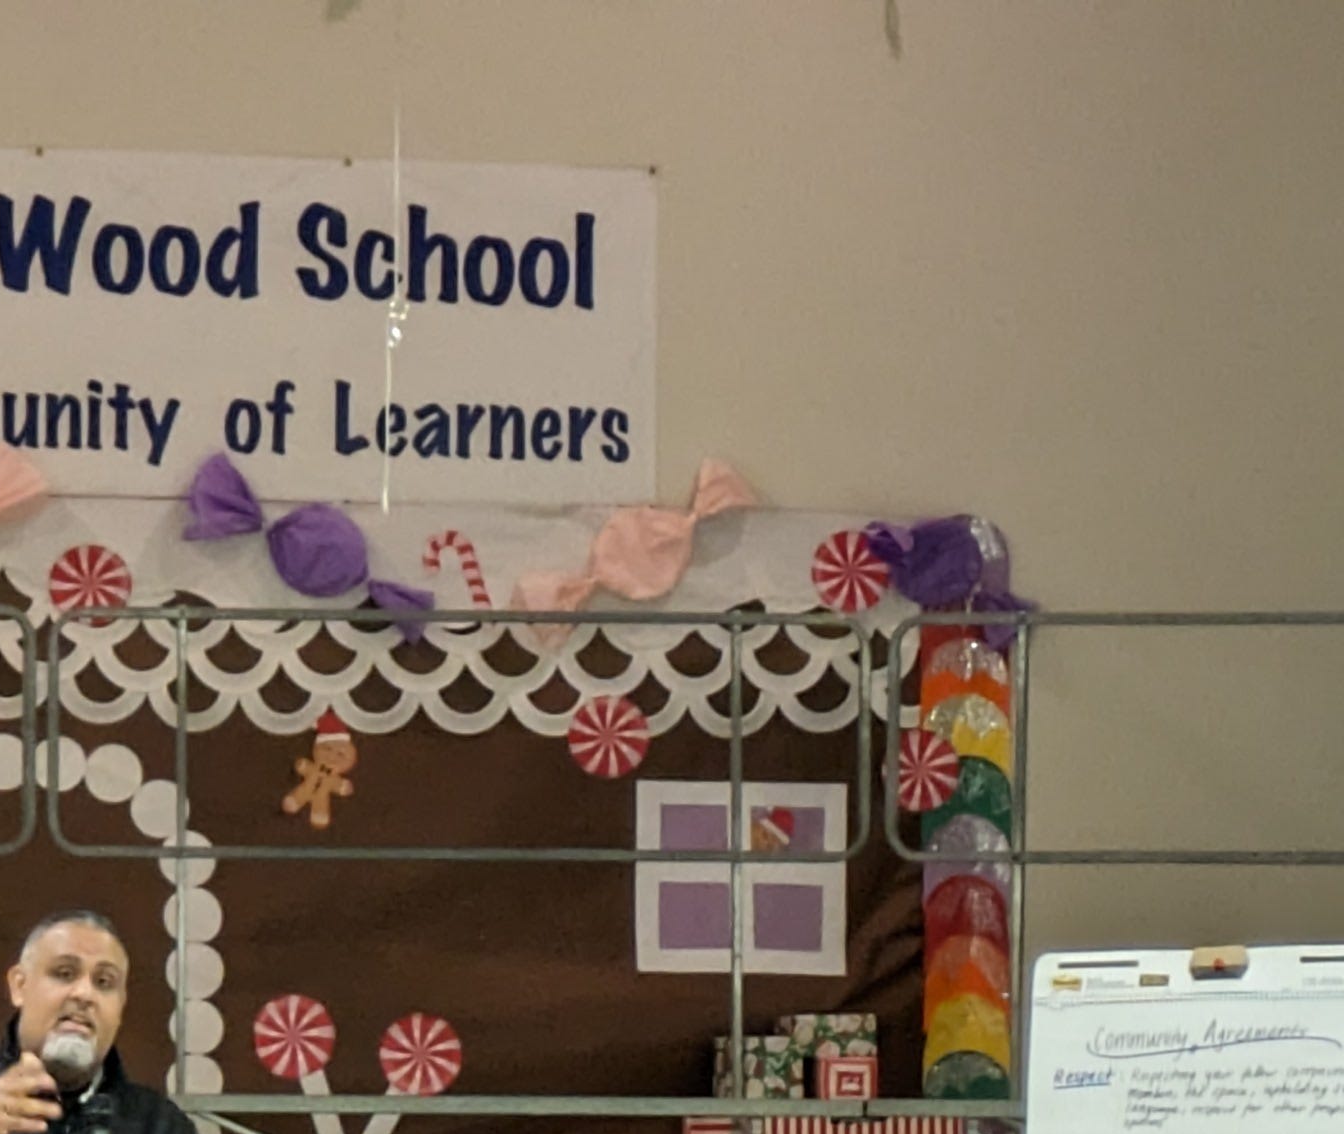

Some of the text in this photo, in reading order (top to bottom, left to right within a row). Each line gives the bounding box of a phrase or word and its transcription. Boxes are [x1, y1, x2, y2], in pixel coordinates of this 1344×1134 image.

[300, 204, 594, 308] School
[228, 384, 291, 452] of
[337, 384, 628, 460] Learners
[1093, 1018, 1308, 1061] Community Agreements
